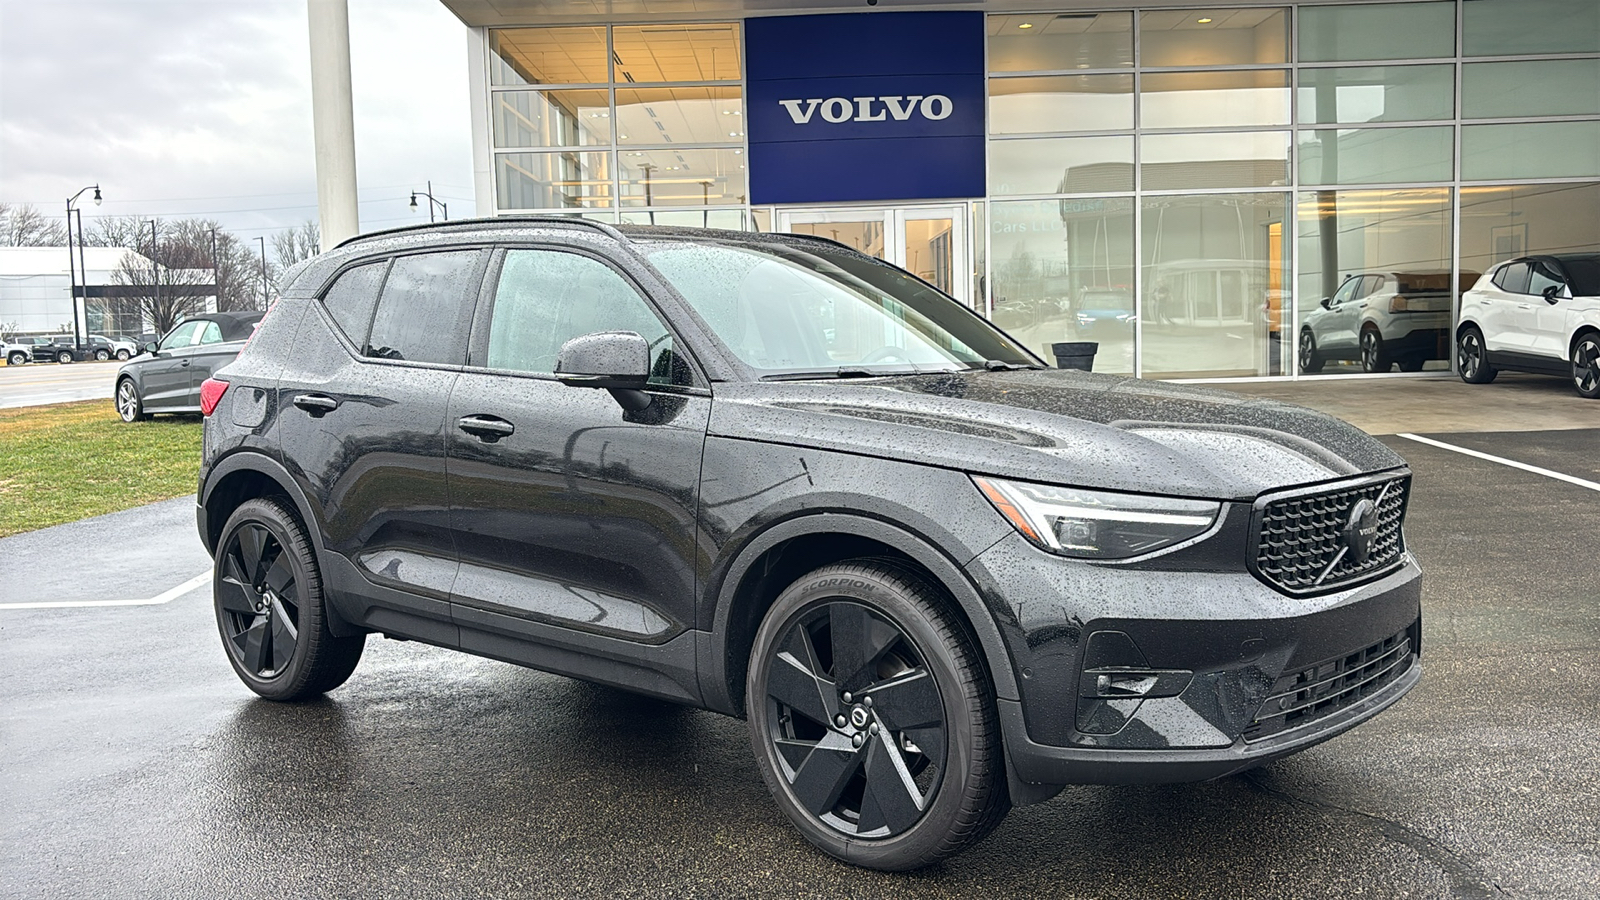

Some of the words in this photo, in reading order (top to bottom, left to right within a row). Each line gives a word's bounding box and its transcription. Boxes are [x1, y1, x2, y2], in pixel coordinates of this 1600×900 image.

[779, 95, 953, 124] VOLVO
[992, 221, 1027, 233] Cars
[1032, 220, 1062, 231] LLC
[801, 578, 876, 595] SCORPION
